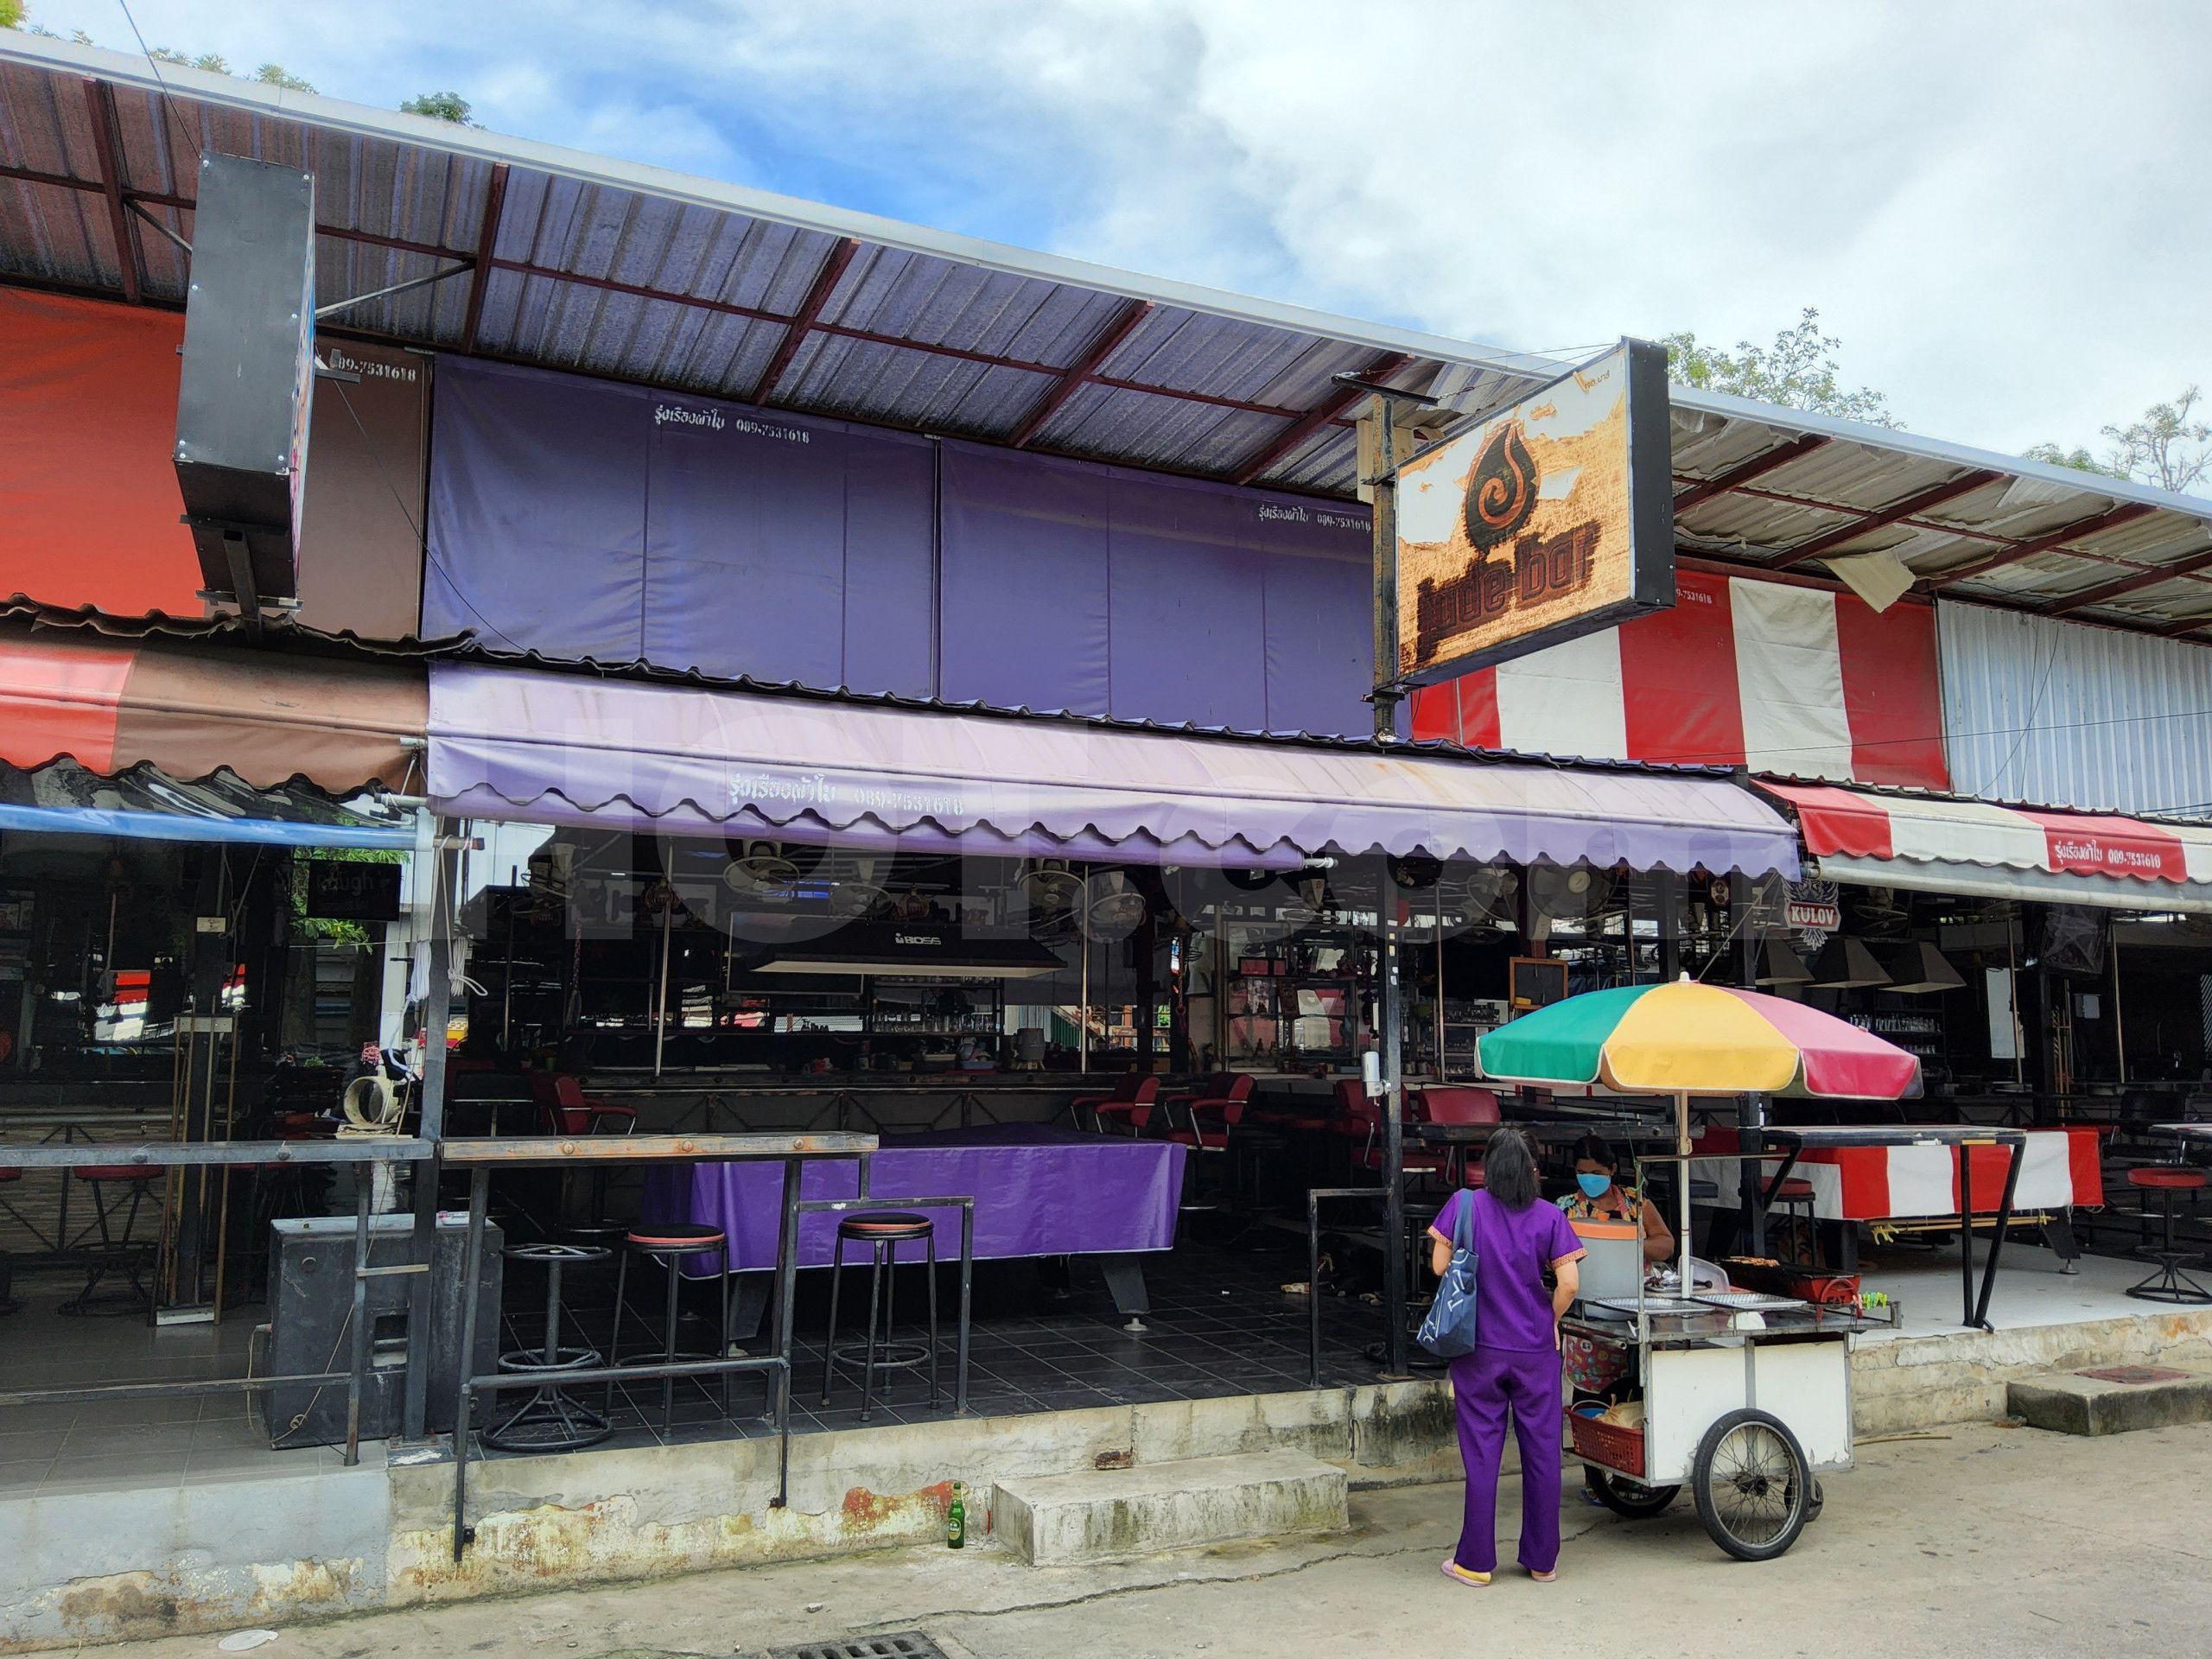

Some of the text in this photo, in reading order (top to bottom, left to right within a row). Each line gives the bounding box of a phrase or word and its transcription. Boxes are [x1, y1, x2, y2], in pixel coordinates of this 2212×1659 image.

[338, 356, 416, 383] 89-7531618
[1790, 905, 1835, 925] KULOV
[904, 936, 942, 945] BOSS
